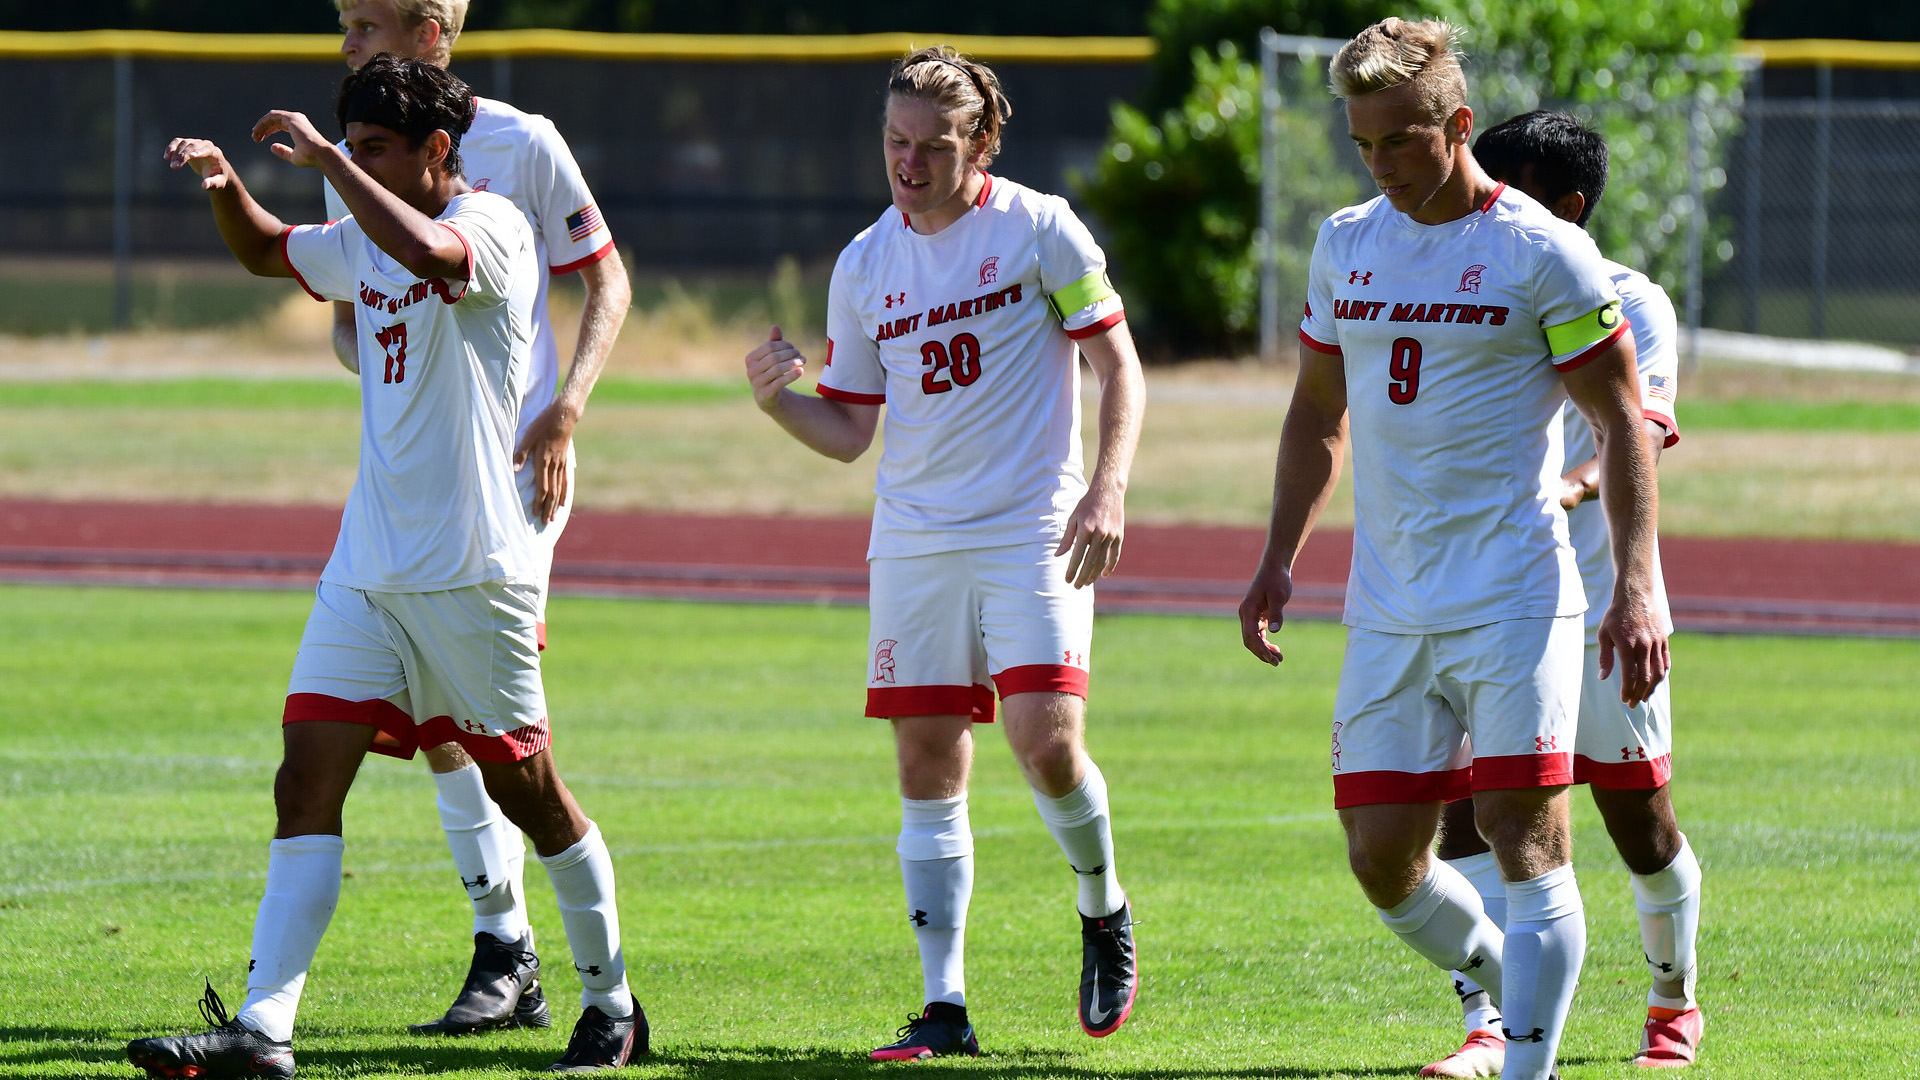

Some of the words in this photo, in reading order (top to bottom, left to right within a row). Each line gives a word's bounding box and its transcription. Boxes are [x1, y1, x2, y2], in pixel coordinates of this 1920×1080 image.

[927, 282, 1022, 327] MARTIN'S
[1388, 302, 1510, 326] MARTIN'S
[1598, 303, 1618, 329] C
[375, 322, 407, 384] 17
[920, 332, 982, 395] 20
[1388, 336, 1423, 405] 9
